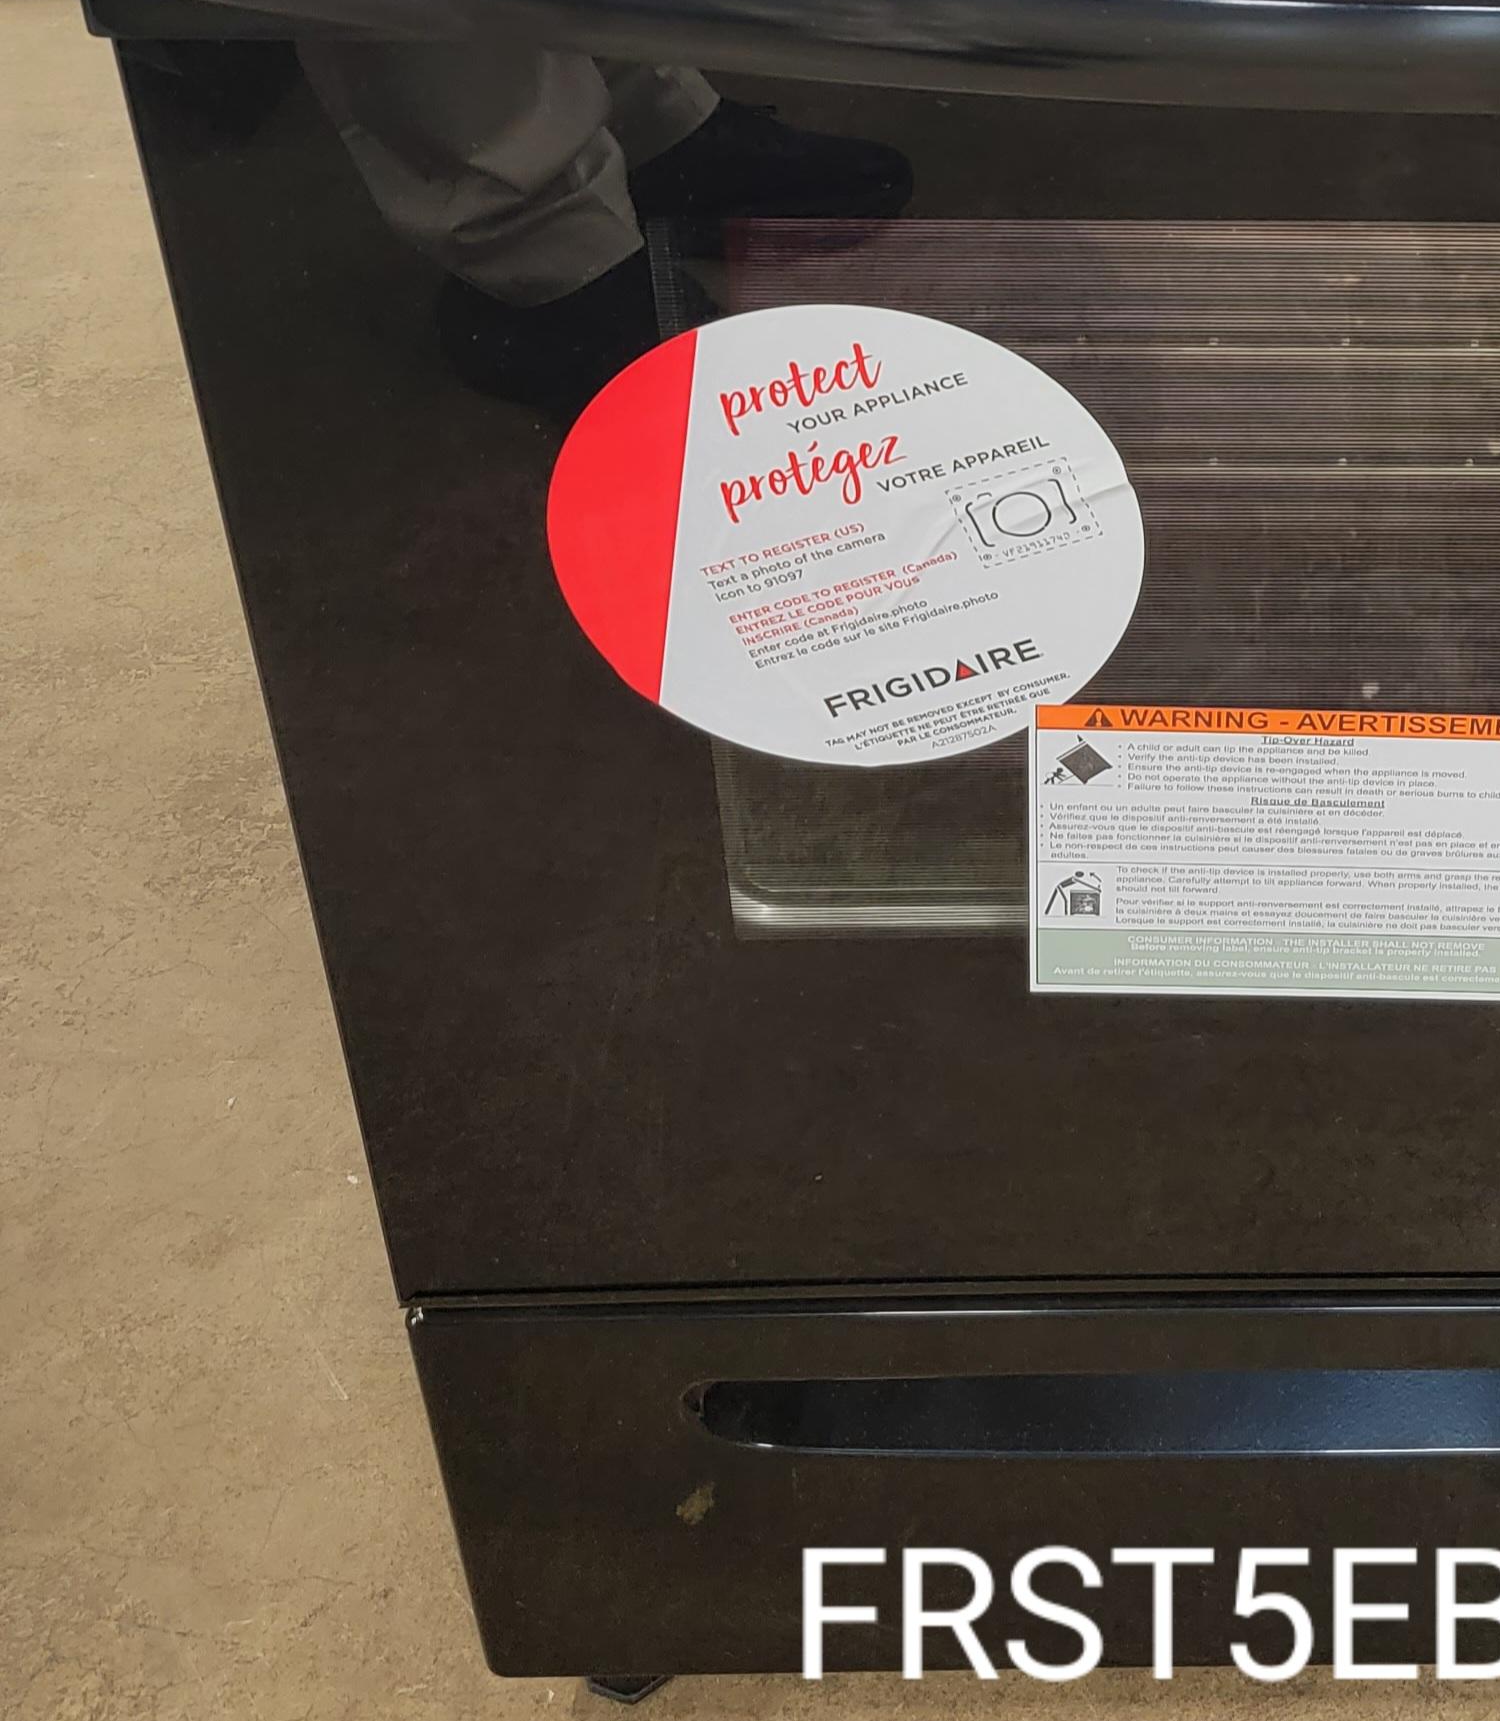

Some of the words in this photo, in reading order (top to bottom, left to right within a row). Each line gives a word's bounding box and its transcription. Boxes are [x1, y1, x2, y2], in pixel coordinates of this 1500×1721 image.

[720, 343, 882, 436] protect
[786, 408, 847, 433] YOUR
[853, 372, 968, 417] APPLIANCE
[720, 436, 907, 523] protégez
[876, 464, 947, 492] VOTRE
[952, 435, 1050, 473] APPAREIL
[700, 559, 736, 577] TEXT
[739, 553, 759, 566] TO
[762, 532, 831, 558] REGISTER
[834, 522, 865, 539] (US)
[708, 575, 738, 591] Text
[740, 572, 749, 581] a
[751, 559, 792, 579] photo
[794, 553, 808, 565] of
[810, 547, 833, 562] the
[836, 532, 886, 553] camera
[729, 605, 771, 624] ENTER
[774, 594, 811, 611] CODE
[812, 588, 831, 600] TO
[833, 569, 897, 594] REGISTER
[902, 551, 958, 575] (Canada)
[735, 614, 786, 635] ENTREZ
[787, 607, 805, 620] LE
[807, 597, 844, 614] CODE
[845, 586, 882, 603] POUR
[884, 576, 921, 591] VOUS
[746, 583, 762, 594] to
[764, 569, 804, 588] 91097
[741, 623, 801, 646] INSCRIRE
[803, 606, 859, 628] (Canada)
[748, 641, 781, 659] Enter
[784, 632, 815, 647] code
[817, 627, 830, 639] at
[831, 599, 928, 634] Frigidaire.photo
[754, 651, 796, 670] Entrez
[796, 646, 808, 657] le
[811, 637, 841, 653] code
[843, 632, 862, 644] sur
[864, 625, 876, 637] le
[878, 618, 900, 633] site
[901, 591, 999, 626] Frigidaire.photo
[823, 638, 1042, 718] FRIGIDAIRE
[846, 730, 867, 742] MAY
[868, 723, 890, 735] NOT
[891, 719, 906, 728] BE
[906, 705, 954, 724] REMOVED
[955, 693, 992, 710] EXCEPT
[997, 688, 1010, 698] BY
[1012, 672, 1071, 693] CONSUMER.
[897, 735, 917, 746] PAR
[918, 731, 931, 741] LE
[932, 708, 1017, 736] CONSOMMATEUR.
[917, 721, 933, 731] NE
[933, 714, 957, 727] PEUT
[1029, 688, 1050, 699] QUE
[1121, 709, 1269, 729] WARNING
[1261, 735, 1311, 745] Tip-Over
[1313, 737, 1354, 747] Hazard
[1251, 796, 1290, 806] Risque
[1293, 796, 1308, 806] de
